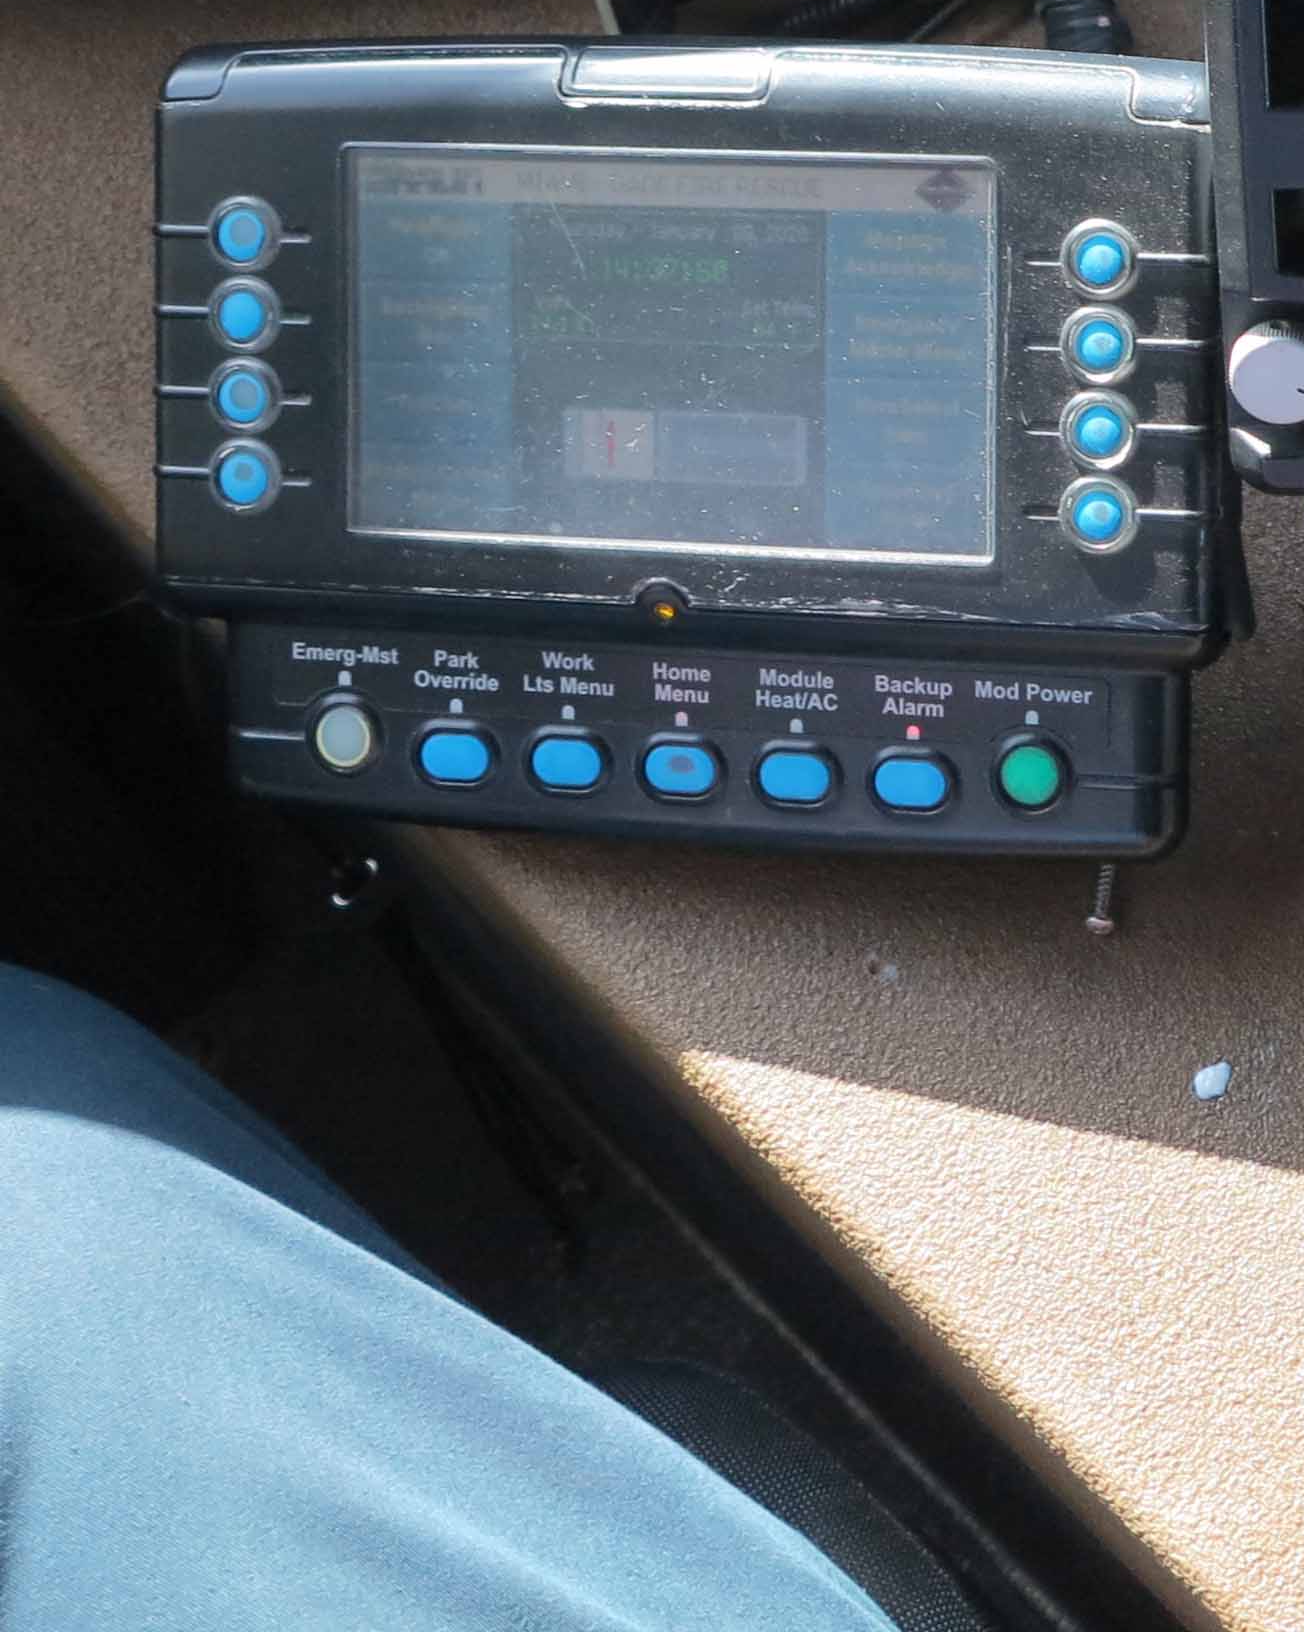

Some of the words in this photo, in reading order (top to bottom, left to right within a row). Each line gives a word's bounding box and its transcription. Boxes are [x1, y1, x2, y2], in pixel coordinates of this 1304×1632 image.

[291, 641, 399, 666] Emerg-Mst
[433, 649, 480, 669] Park
[541, 650, 595, 671] Work
[414, 669, 499, 692] Override
[651, 661, 712, 683] Home
[759, 668, 835, 690] Module
[523, 674, 555, 695] Lts
[560, 676, 614, 697] Menu
[654, 683, 710, 704] Menu
[874, 674, 954, 700] Backup
[974, 679, 1020, 702] Mod
[1025, 683, 1093, 706] Power
[755, 689, 839, 712] Heat/AC
[882, 696, 945, 719] Alarm
